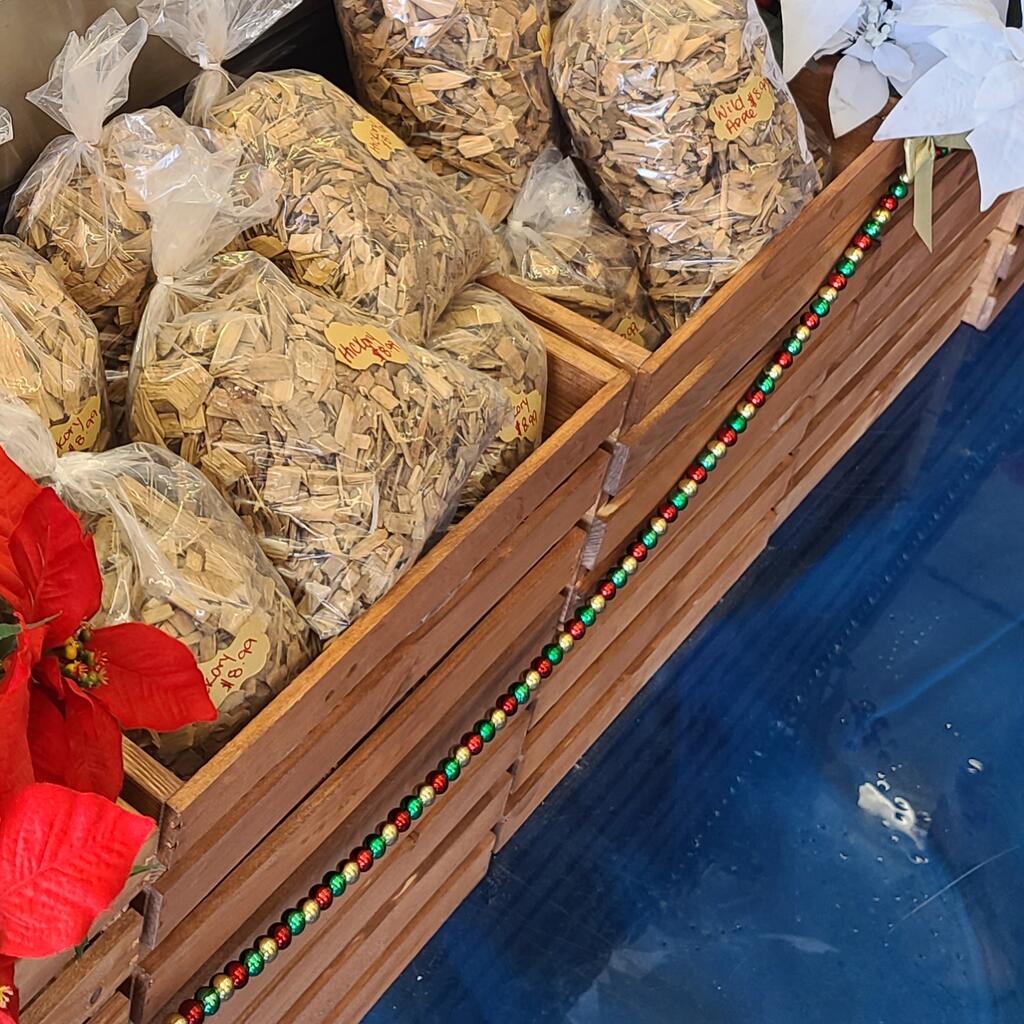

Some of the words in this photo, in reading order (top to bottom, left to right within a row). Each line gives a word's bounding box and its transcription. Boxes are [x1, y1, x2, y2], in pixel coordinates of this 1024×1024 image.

[713, 95, 745, 120] Wild
[725, 109, 758, 134] Apple
[220, 638, 257, 693] $8.99
